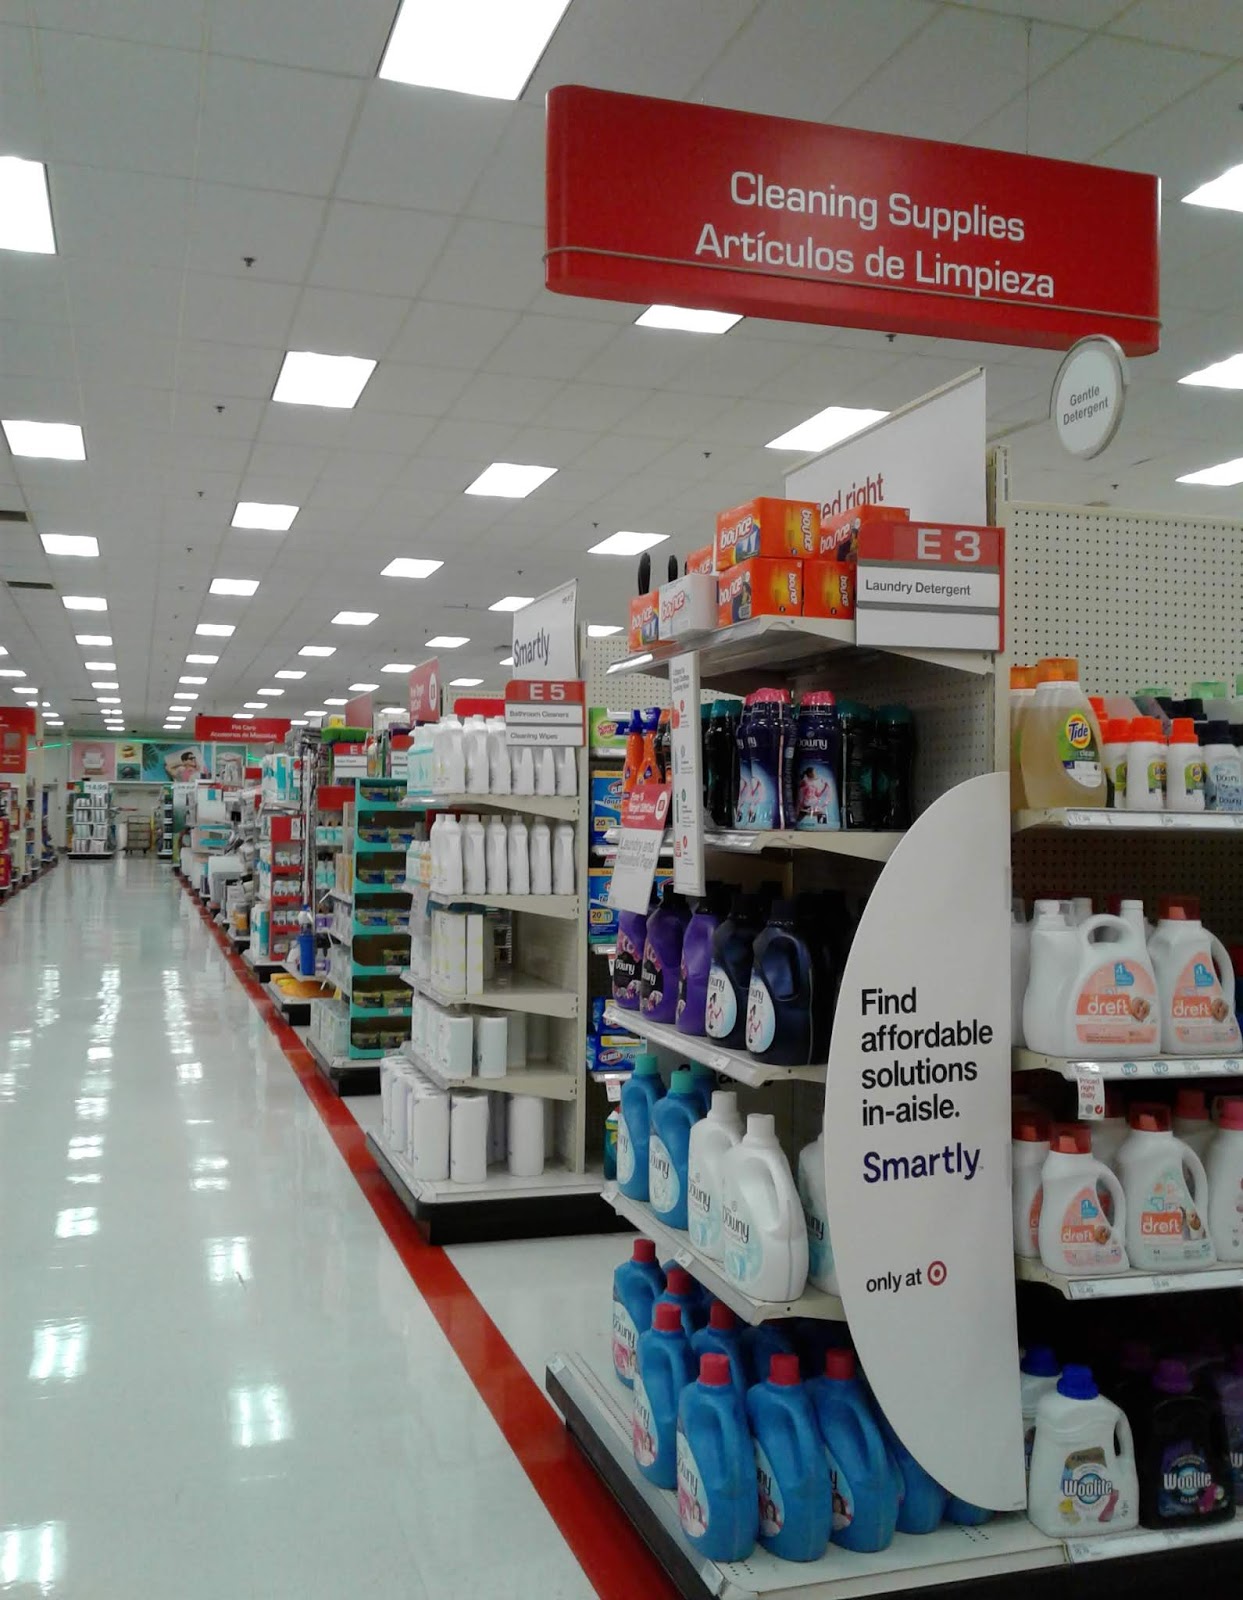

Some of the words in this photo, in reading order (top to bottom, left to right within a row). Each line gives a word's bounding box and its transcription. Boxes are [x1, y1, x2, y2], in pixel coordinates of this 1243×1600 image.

[730, 170, 878, 230] Cleaning
[888, 193, 1025, 242] Supplies
[696, 222, 854, 274] Artículos
[865, 246, 905, 280] de
[916, 252, 1054, 298] Limpieza
[1069, 385, 1100, 407] Gentle
[1063, 396, 1109, 426] Detergent
[917, 528, 941, 561] E
[954, 530, 981, 562] 3
[865, 578, 913, 595] Laundry
[915, 582, 971, 597] Detergent
[513, 627, 551, 668] Smartly
[530, 684, 544, 700] E
[550, 684, 565, 700] 5
[510, 732, 538, 741] Cleaning
[1068, 722, 1088, 742] Tide
[799, 737, 828, 750] owny
[592, 911, 602, 919] 20
[861, 986, 917, 1016] Find
[1088, 995, 1130, 1016] dreft
[1173, 997, 1209, 1017] dreft
[861, 1018, 993, 1052] affordable
[861, 1057, 978, 1089] solutions
[861, 1093, 961, 1126] in-aisle.
[863, 1142, 980, 1184] Smartly
[1062, 1227, 1093, 1243] dreft
[1142, 1217, 1180, 1235] dreft
[866, 1271, 902, 1293] only
[905, 1268, 922, 1287] at
[1063, 1478, 1113, 1497] Woolite
[1163, 1472, 1212, 1491] Woolite
